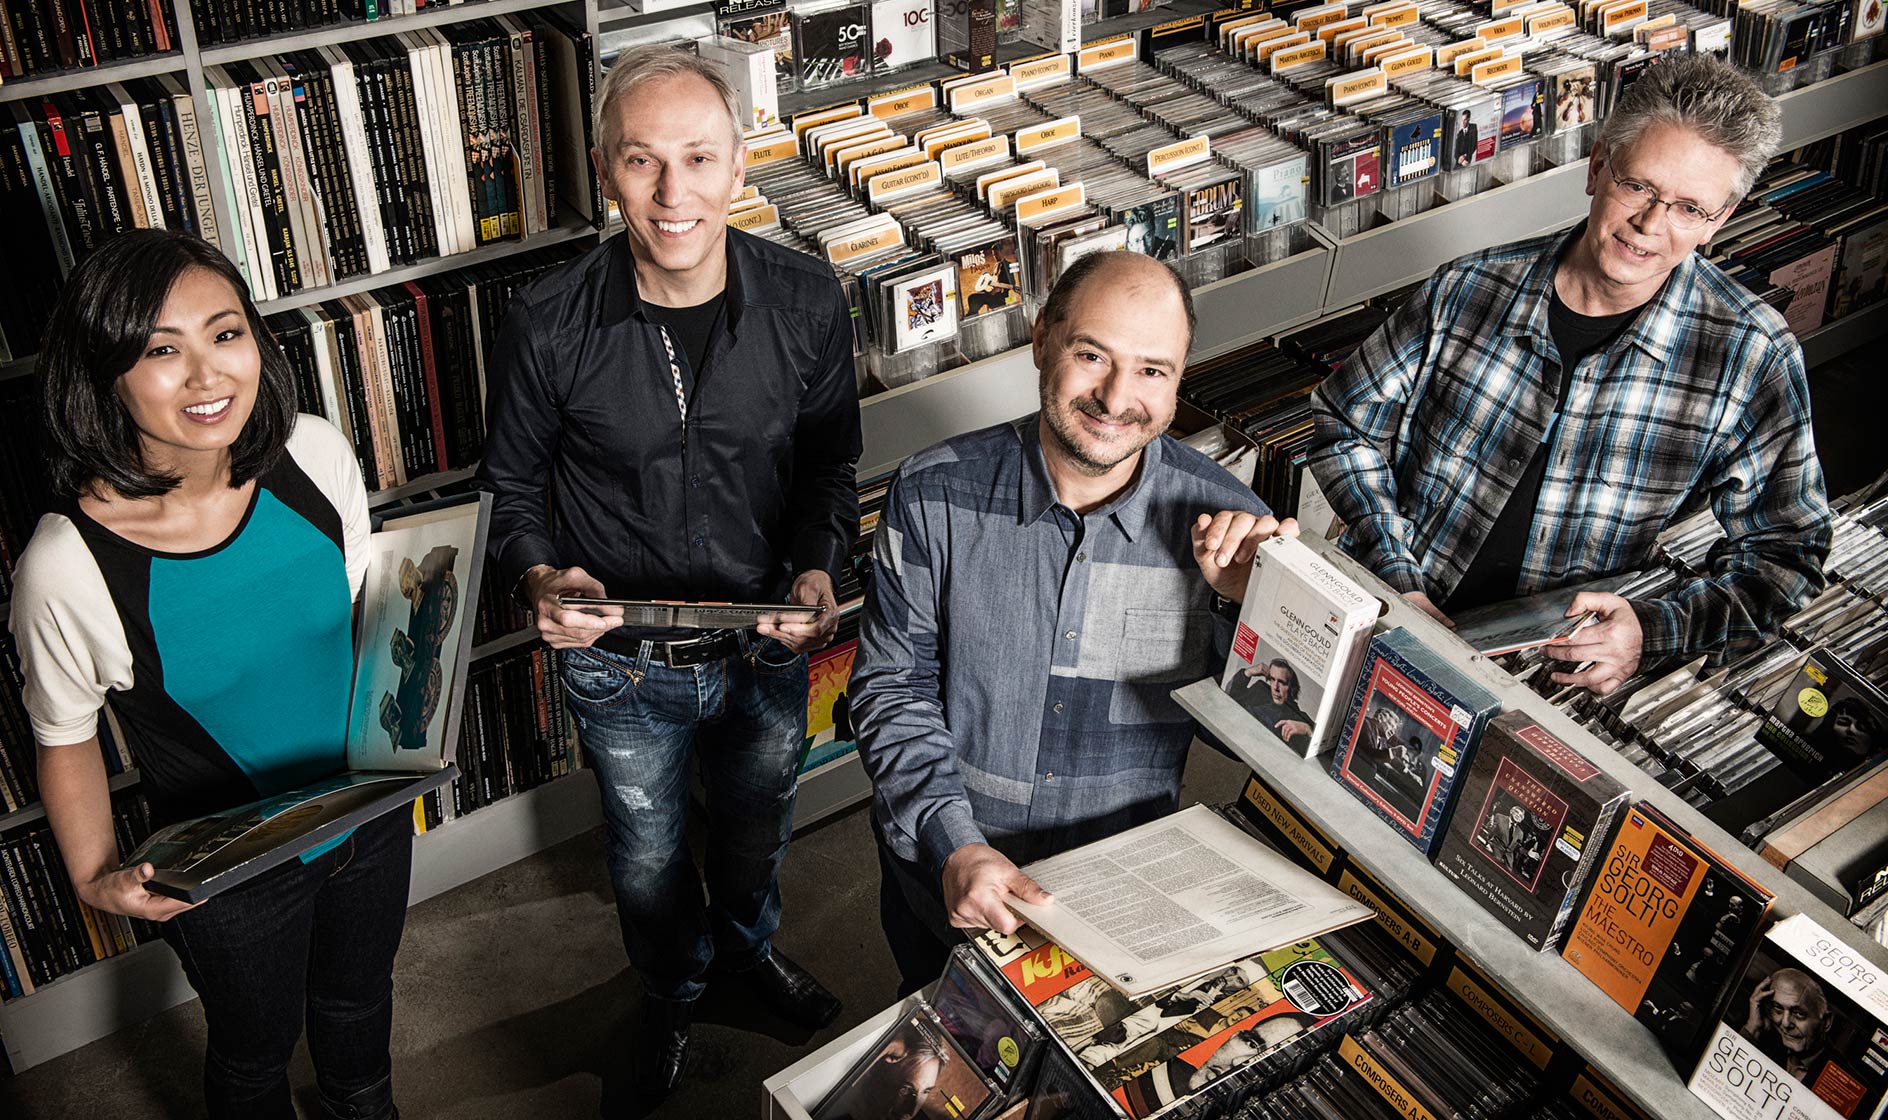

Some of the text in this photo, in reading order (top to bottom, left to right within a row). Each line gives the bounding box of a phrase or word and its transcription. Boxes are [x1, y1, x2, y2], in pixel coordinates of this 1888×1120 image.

[1099, 50, 1115, 60] PIANO
[1486, 63, 1508, 76] RECORDER
[974, 87, 994, 98] ORGAN
[182, 112, 198, 157] HENZE
[244, 93, 259, 141] HUMPERDINCK
[261, 185, 272, 207] GRETEL
[753, 149, 772, 160] FLUTE
[1040, 129, 1056, 140] OBOE
[234, 105, 248, 149] Humperdinck
[248, 188, 260, 207] Gretel
[143, 182, 154, 204] MONDO
[192, 166, 205, 190] DER
[881, 174, 904, 190] GUITAR
[198, 193, 213, 231] JUNGE
[1041, 197, 1058, 208] HARP
[850, 237, 879, 252] CLARINET
[1280, 606, 1331, 648] GLENN GOULD
[1286, 622, 1329, 657] PLAYS BACH
[1381, 677, 1446, 729] YOUNG PEOPLE'S CONCERTS
[1505, 774, 1558, 815] UNANSWERED
[1509, 785, 1547, 816] QUESTION
[1526, 780, 1541, 793] THE
[1251, 789, 1326, 866] USED NEW ARRIVALS
[1617, 845, 1640, 868] SIR
[1460, 869, 1522, 922] LEONARD BERNSTEIN
[1465, 863, 1487, 883] TALKS
[1494, 886, 1524, 913] HARVARD
[1592, 894, 1616, 918] THE
[1601, 875, 1658, 928] SOLTI
[1608, 858, 1679, 919] GEORG
[1349, 884, 1402, 936] COMPOSERS
[1401, 929, 1422, 952] A-B
[1585, 907, 1654, 967] MAESTRO
[1577, 936, 1592, 949] WIENER
[1579, 932, 1596, 946] CHICAGO
[1618, 964, 1642, 984] ORCHESTRA
[1816, 938, 1877, 986] GEORG
[1805, 944, 1868, 993] SOLTI
[1461, 983, 1514, 1036] COMPOSERS
[1724, 1030, 1737, 1042] SIR
[1353, 1053, 1409, 1112] COMPOSERS
[1709, 1054, 1786, 1120] SOLTI
[1717, 1037, 1792, 1103] GEORG
